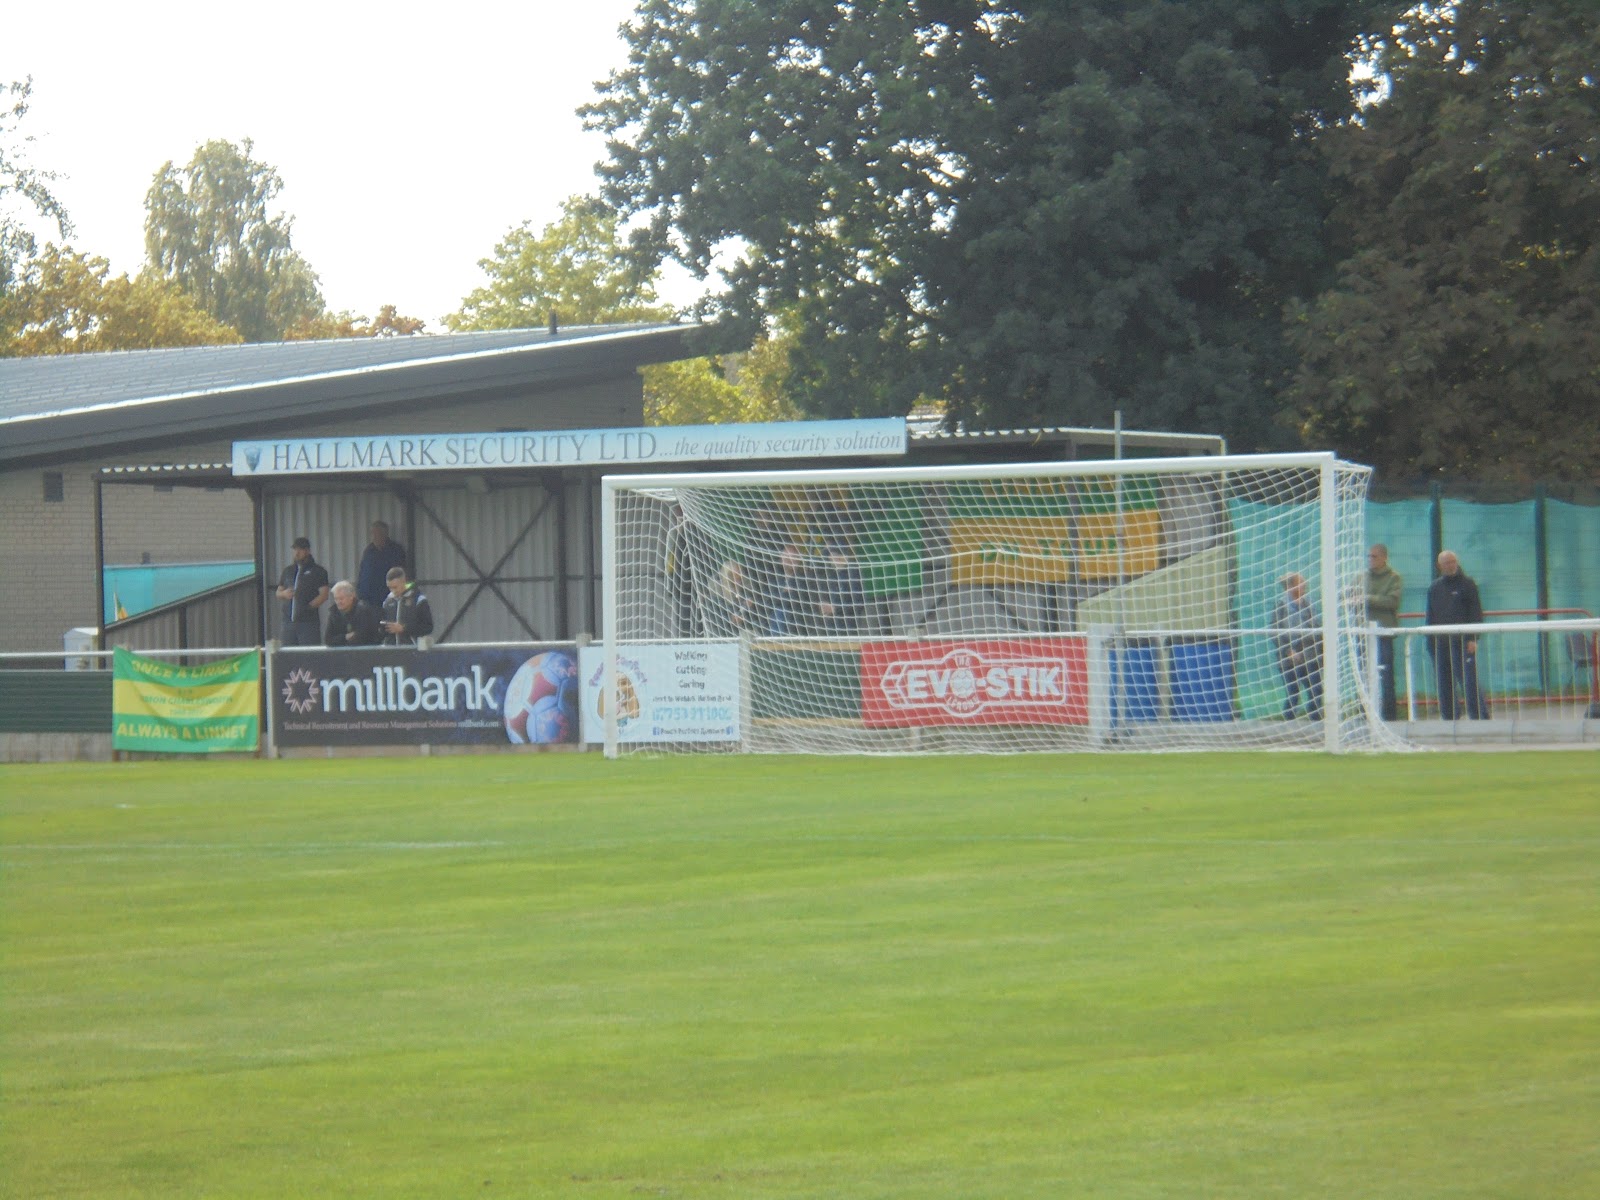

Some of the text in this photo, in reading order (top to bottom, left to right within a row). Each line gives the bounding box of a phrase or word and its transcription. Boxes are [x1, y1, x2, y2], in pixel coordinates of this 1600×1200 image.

[271, 438, 438, 471] HALLMARK
[445, 433, 590, 466] SECURITY
[600, 431, 657, 460] LTD
[703, 435, 761, 460] quality
[764, 433, 831, 456] security
[833, 430, 901, 451] solution
[674, 651, 708, 661] Walking
[177, 667, 187, 678] A
[676, 665, 707, 676] Cutting
[320, 665, 498, 712] millbank
[458, 719, 499, 728] millbank.com
[116, 723, 247, 739] ALWAYS A LINNET
